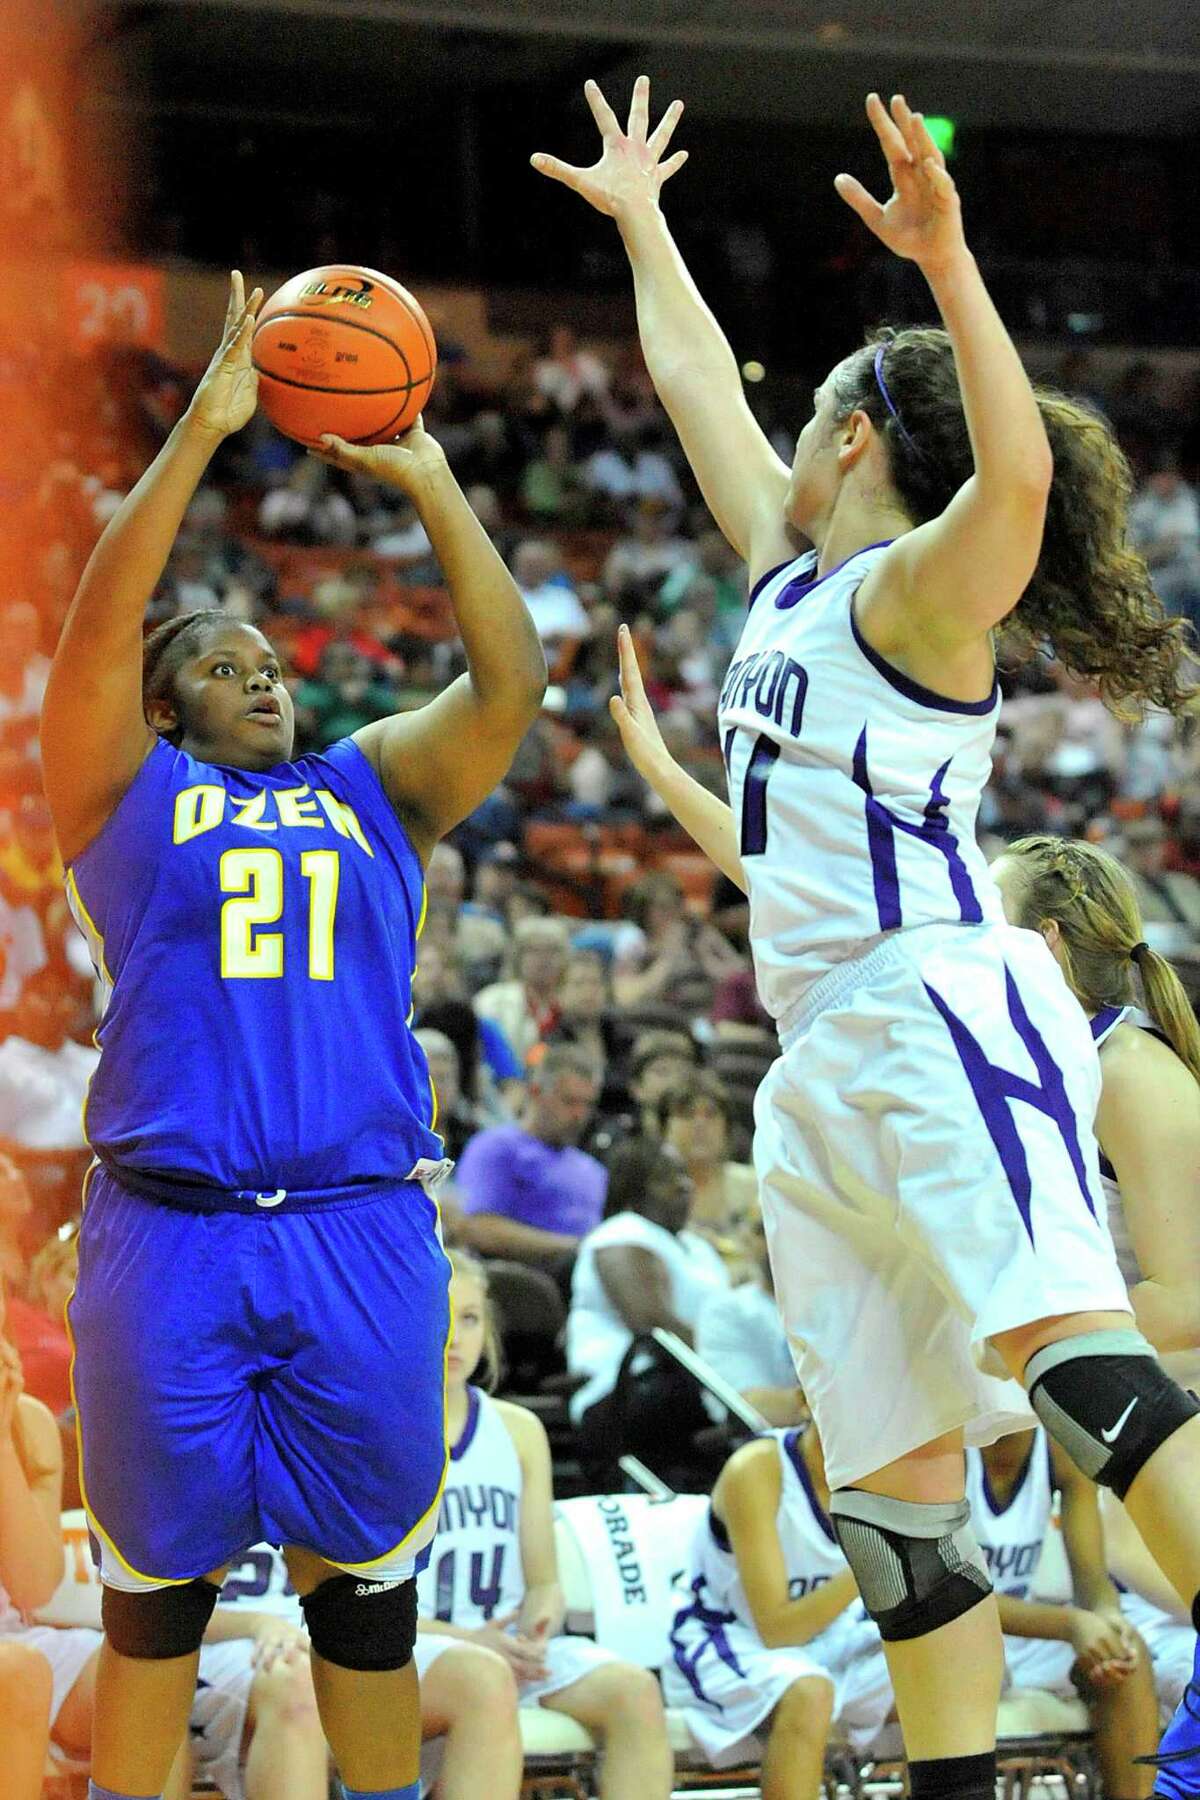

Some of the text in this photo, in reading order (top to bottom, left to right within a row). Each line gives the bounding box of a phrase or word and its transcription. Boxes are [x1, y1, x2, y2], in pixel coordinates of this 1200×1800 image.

[721, 649, 808, 738] NYON
[172, 784, 375, 859] OZEN
[219, 847, 340, 981] 21
[435, 1546, 506, 1622] 14
